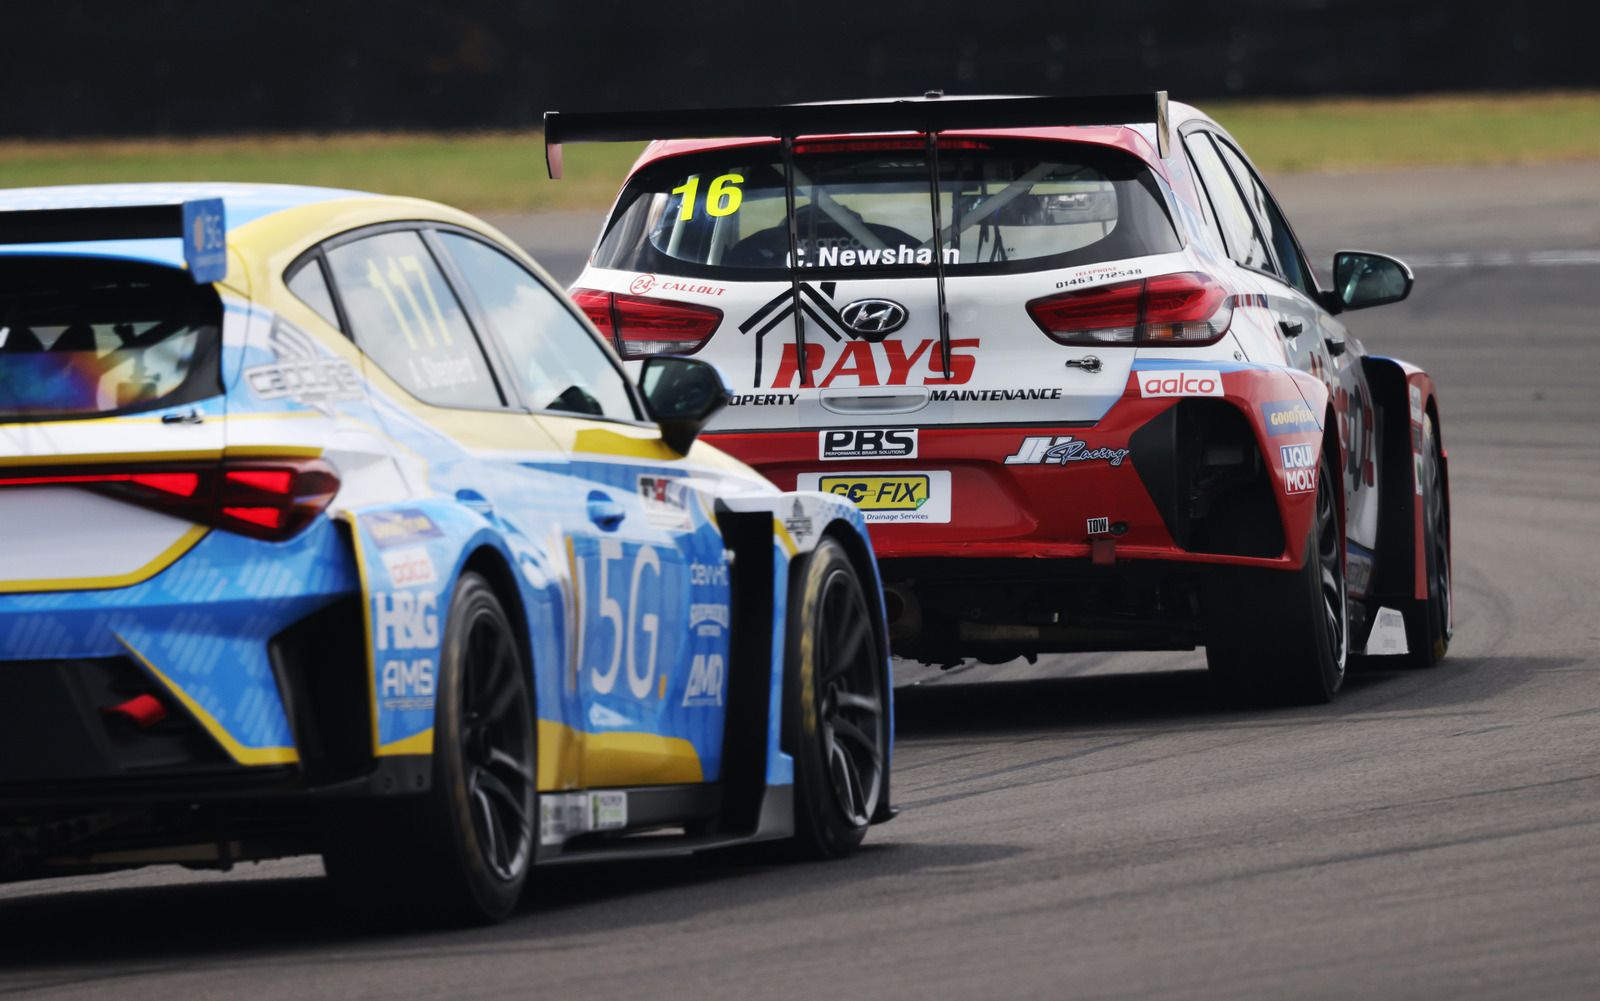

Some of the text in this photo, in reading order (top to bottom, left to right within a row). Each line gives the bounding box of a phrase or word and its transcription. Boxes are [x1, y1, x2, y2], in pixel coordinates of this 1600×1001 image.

[672, 174, 744, 221] 16
[819, 244, 960, 267] Newsham
[1056, 268, 1142, 289] 01463 712548
[1075, 267, 1117, 277] TELEPHONE
[662, 282, 726, 296] CALLOUT
[771, 338, 979, 388] RAYS
[1145, 373, 1215, 394] aalco
[728, 388, 1062, 406] OPERTY MAINTENANCE
[824, 430, 914, 457] PBS
[1046, 441, 1130, 466] Racing
[1283, 446, 1315, 468] LIQUI
[1286, 469, 1316, 492] MOLY
[866, 513, 898, 521] Drainage
[900, 512, 929, 520] Services
[1088, 518, 1108, 533] TOW
[382, 660, 433, 697] AMS
